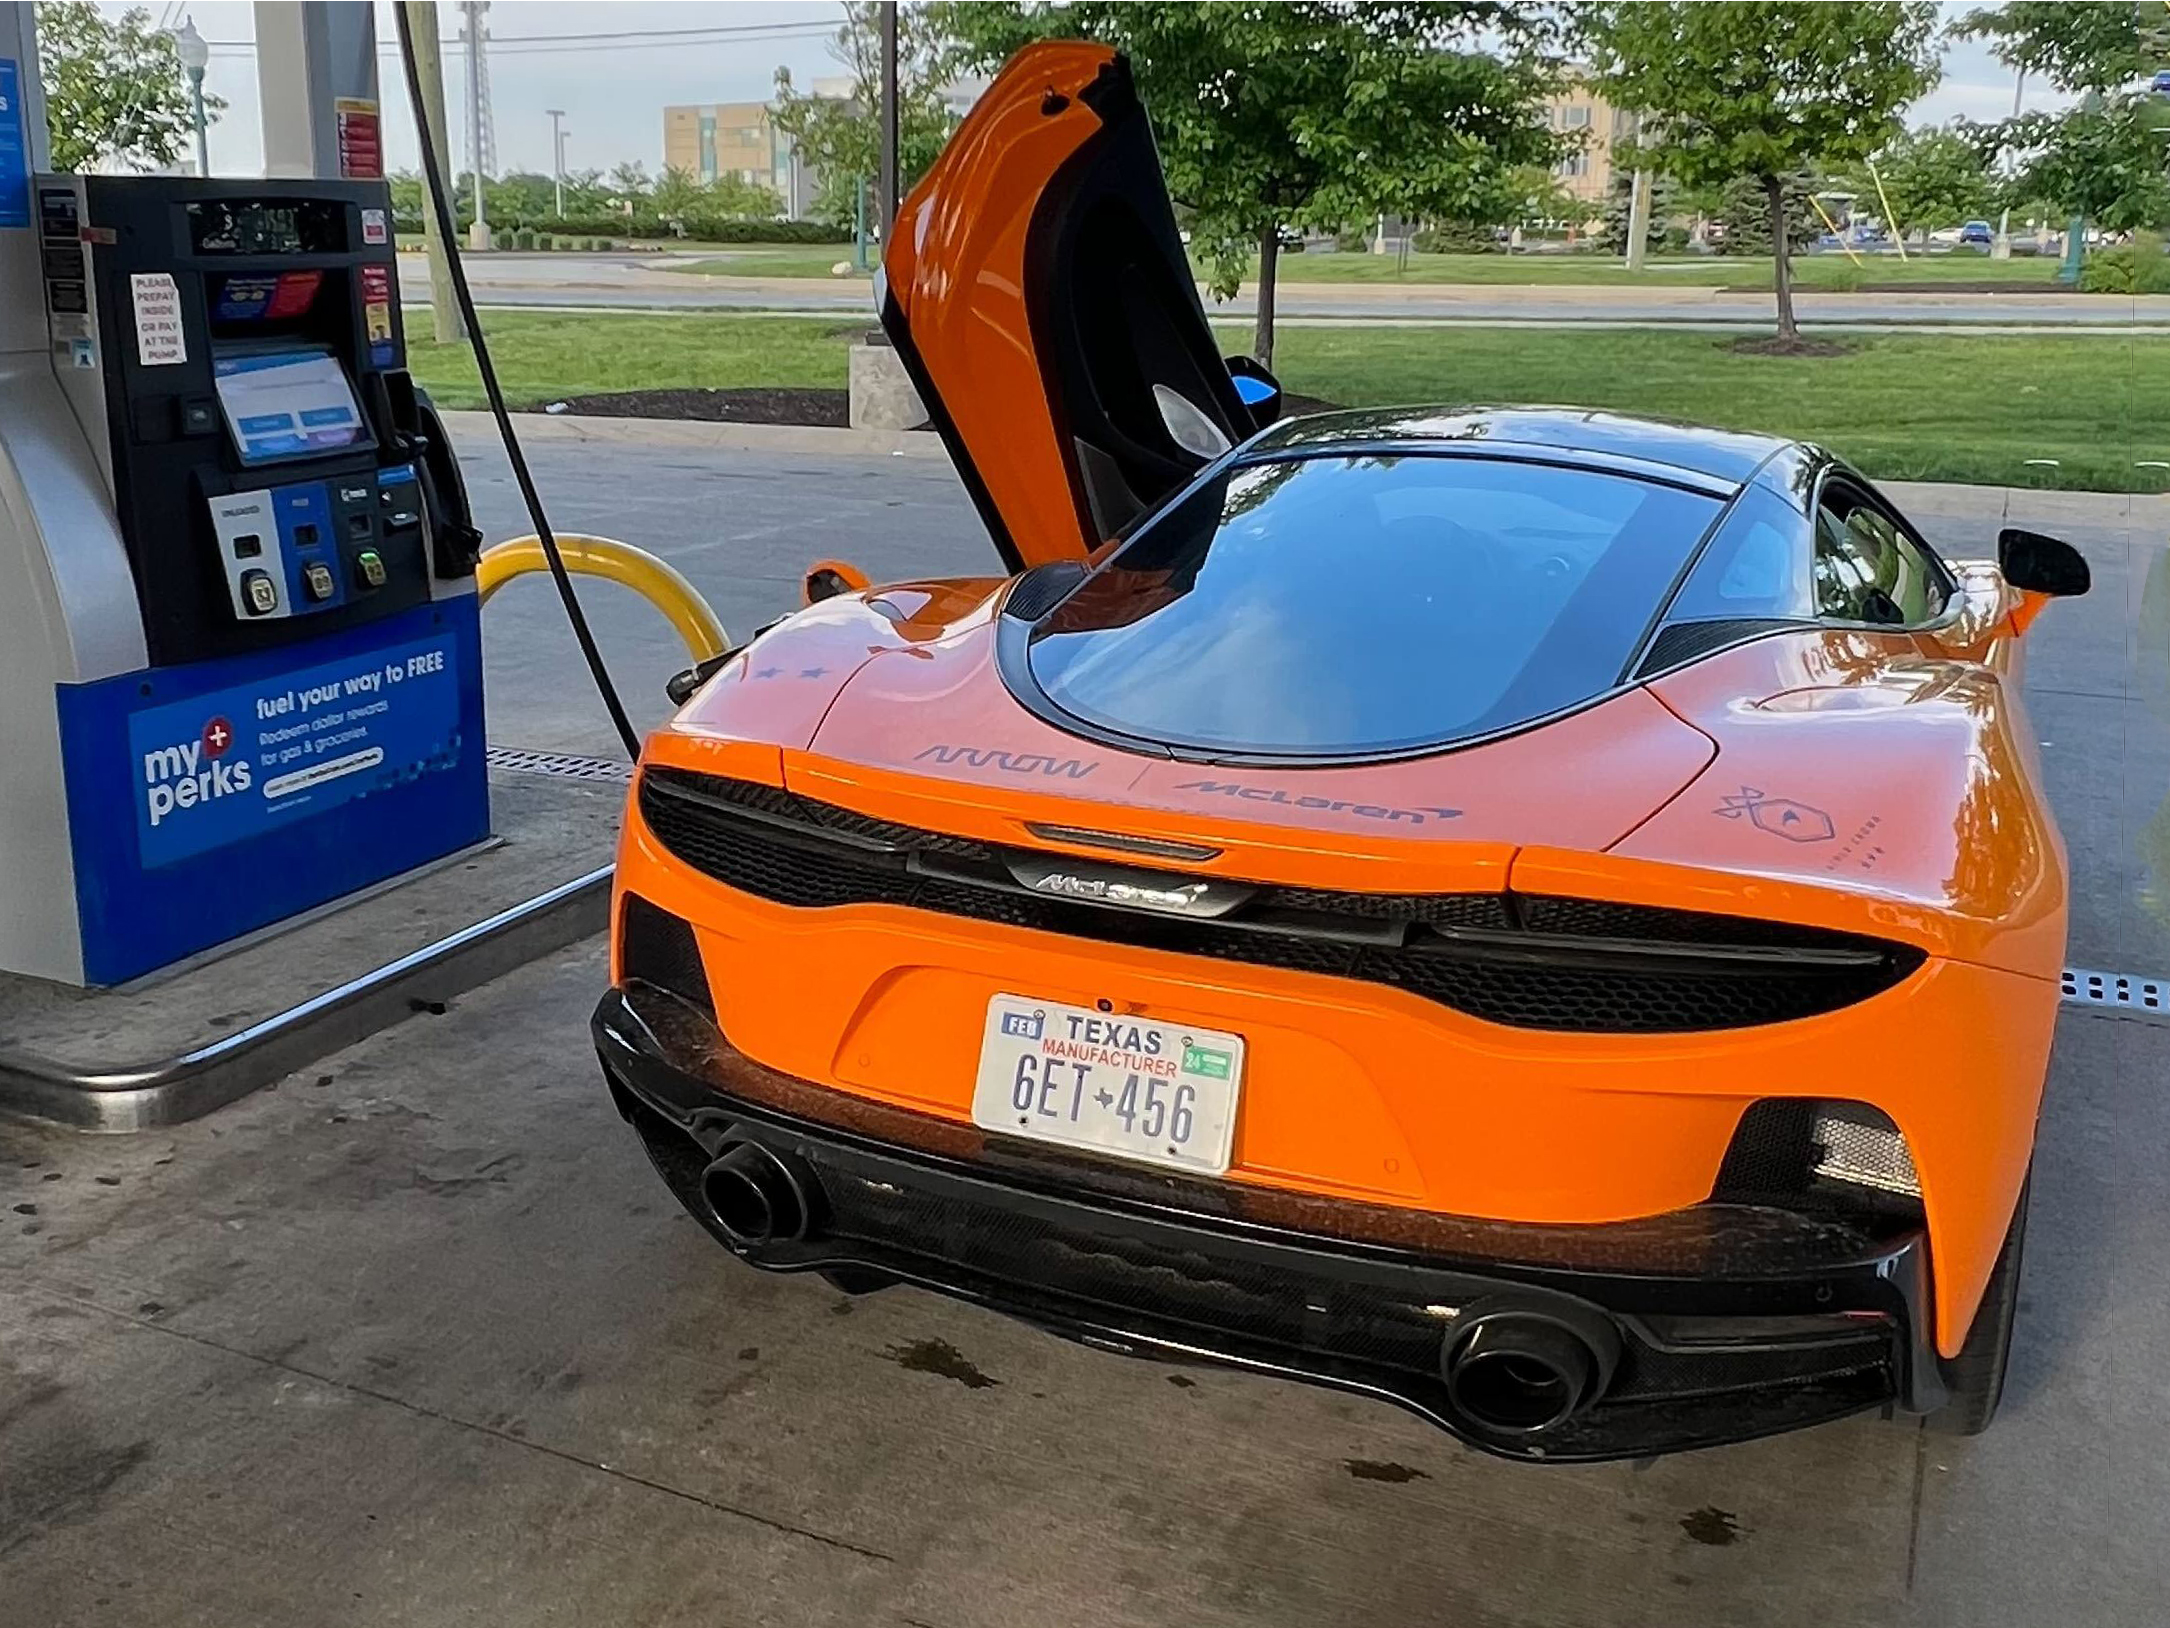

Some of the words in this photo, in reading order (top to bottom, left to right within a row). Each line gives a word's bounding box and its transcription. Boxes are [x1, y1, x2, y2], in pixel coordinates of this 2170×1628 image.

[137, 291, 175, 301] PREPAY
[158, 321, 177, 331] PAY
[144, 336, 156, 346] AT
[148, 349, 178, 360] PUMP
[257, 691, 295, 719] fuel
[298, 681, 341, 712] your
[344, 670, 383, 695] way
[386, 663, 405, 684] to
[407, 650, 445, 678] FREE
[259, 723, 310, 745] Redeem
[145, 739, 203, 783] my
[279, 745, 302, 763] gas
[914, 745, 1100, 778] ARROW
[148, 759, 252, 826] perks
[1173, 781, 1425, 824] McLaren
[1008, 1016, 1038, 1037] FEB
[1066, 1014, 1163, 1055] TEXAS
[1042, 1038, 1178, 1078] MANUFACTURER
